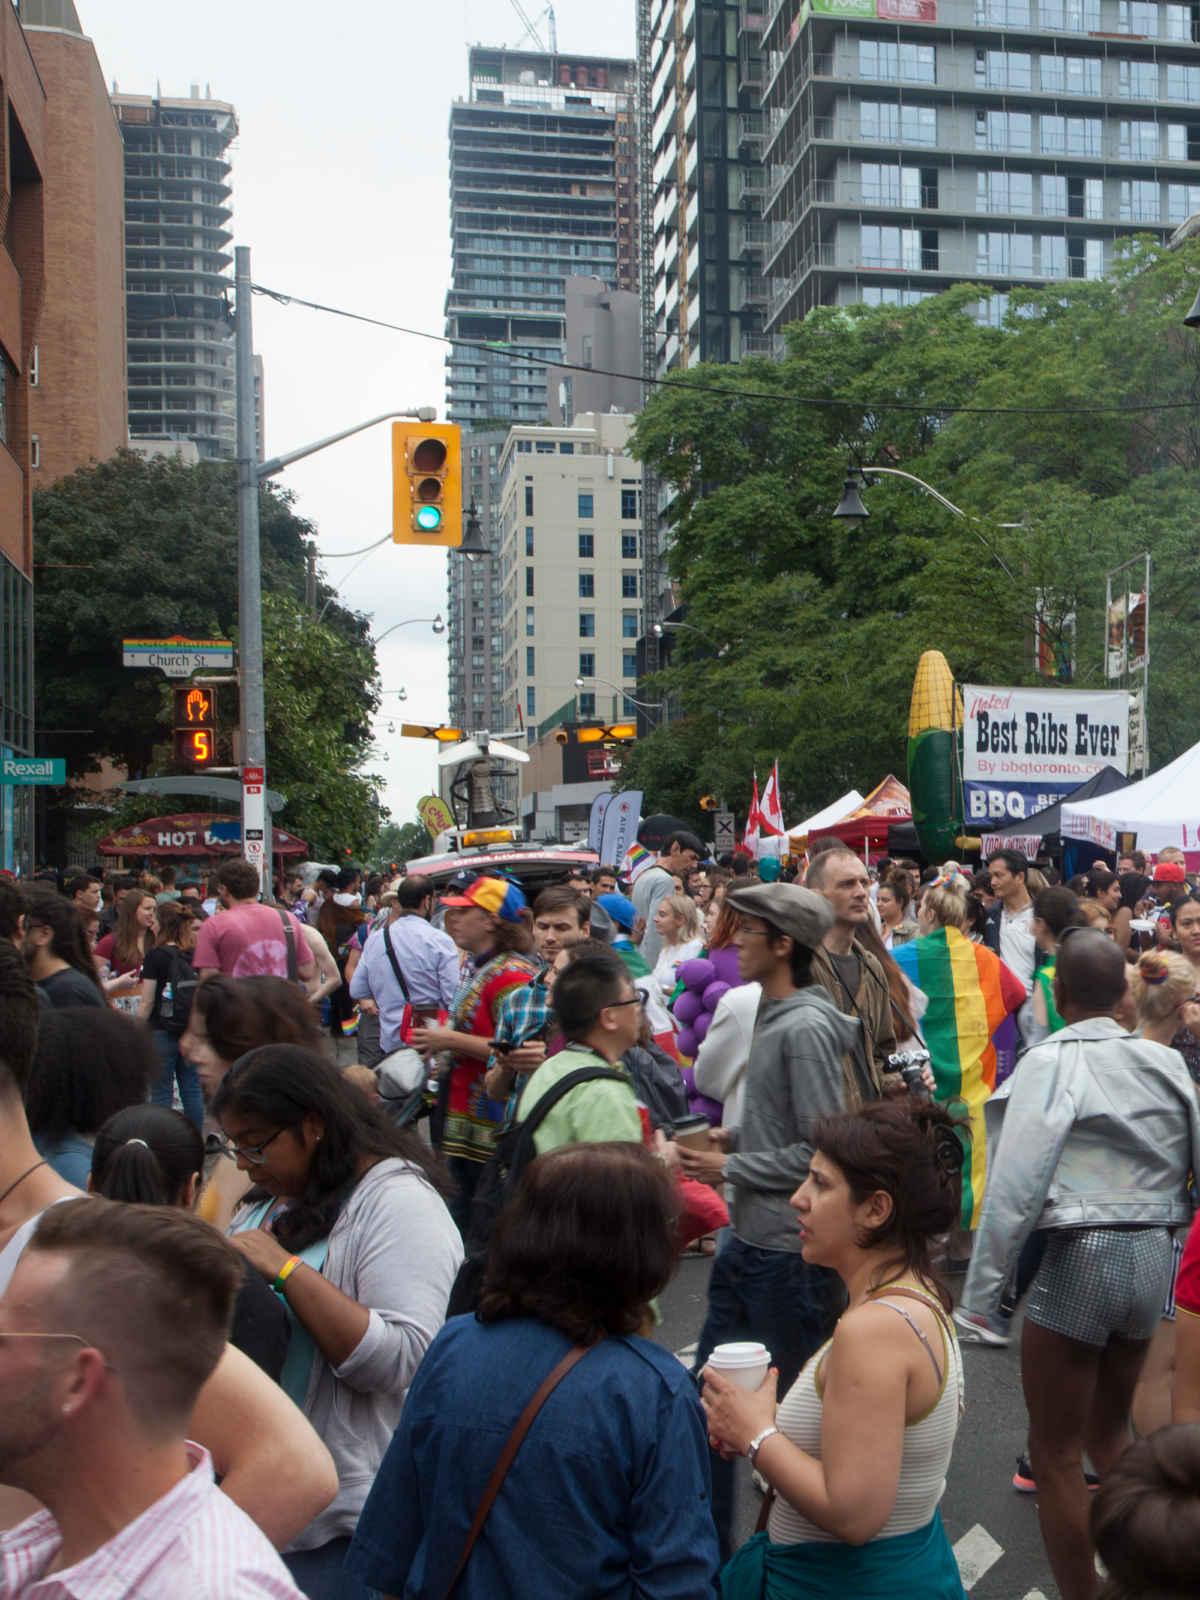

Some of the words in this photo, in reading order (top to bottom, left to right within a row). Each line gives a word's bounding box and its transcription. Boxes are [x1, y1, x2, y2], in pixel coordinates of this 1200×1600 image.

[148, 655, 189, 667] Church
[193, 655, 208, 667] St.
[976, 710, 1018, 754] Best
[1024, 711, 1068, 755] Ribs
[1075, 713, 1120, 757] Ever
[194, 731, 208, 760] 5
[3, 760, 53, 776] Rexall
[977, 759, 996, 775] By
[969, 790, 1026, 820] BBQ
[157, 831, 197, 847] HOT
